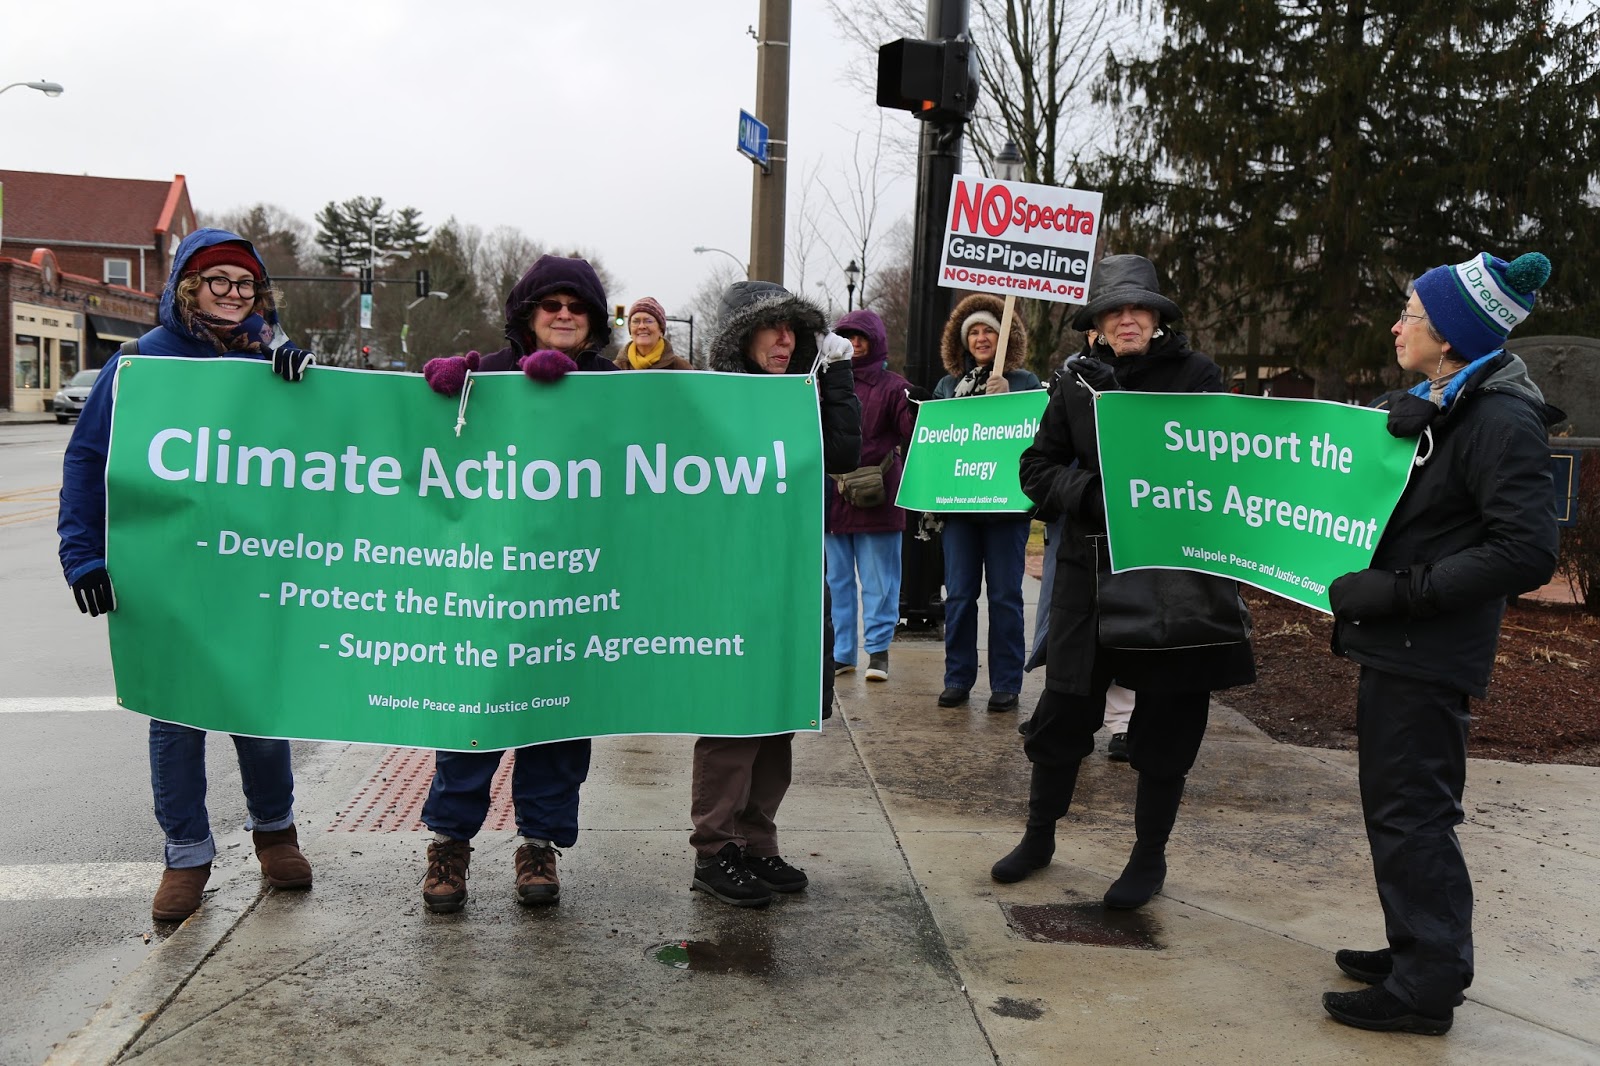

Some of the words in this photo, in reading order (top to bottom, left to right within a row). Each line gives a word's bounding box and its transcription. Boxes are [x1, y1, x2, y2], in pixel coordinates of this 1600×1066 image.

[951, 181, 1013, 237] NO
[1012, 196, 1095, 235] Spectra
[949, 238, 986, 261] Gas
[986, 243, 1087, 275] Pipeline
[943, 267, 1085, 299] NOspectraMA.org
[1466, 267, 1517, 324] Oregon
[918, 424, 968, 445] Develop
[1164, 420, 1301, 463] Support
[1310, 433, 1353, 474] the
[148, 427, 402, 496] Climate
[418, 445, 602, 500] Action
[625, 440, 788, 495] Now!
[954, 458, 997, 480] Energy
[967, 496, 976, 504] and
[992, 496, 1008, 505] Group
[1129, 479, 1213, 512] Paris
[1222, 485, 1377, 550] Agreement
[218, 530, 344, 566] Develop
[353, 538, 494, 570] Renewable
[502, 546, 601, 573] Energy
[1181, 545, 1227, 563] Walpole
[1229, 553, 1257, 571] Peace
[1258, 562, 1275, 577] and
[1275, 566, 1301, 586] Justice
[1301, 576, 1326, 596] Group
[279, 582, 387, 612] Protect
[395, 588, 438, 615] the
[444, 588, 621, 620] Environment
[338, 633, 448, 667] Support
[454, 640, 498, 668] the
[508, 638, 576, 667] Paris
[583, 634, 745, 662] Agreement
[368, 694, 420, 710] Walpole
[422, 698, 456, 712] Peace
[458, 700, 482, 714] and
[484, 700, 529, 715] Justice
[531, 694, 571, 710] Group
